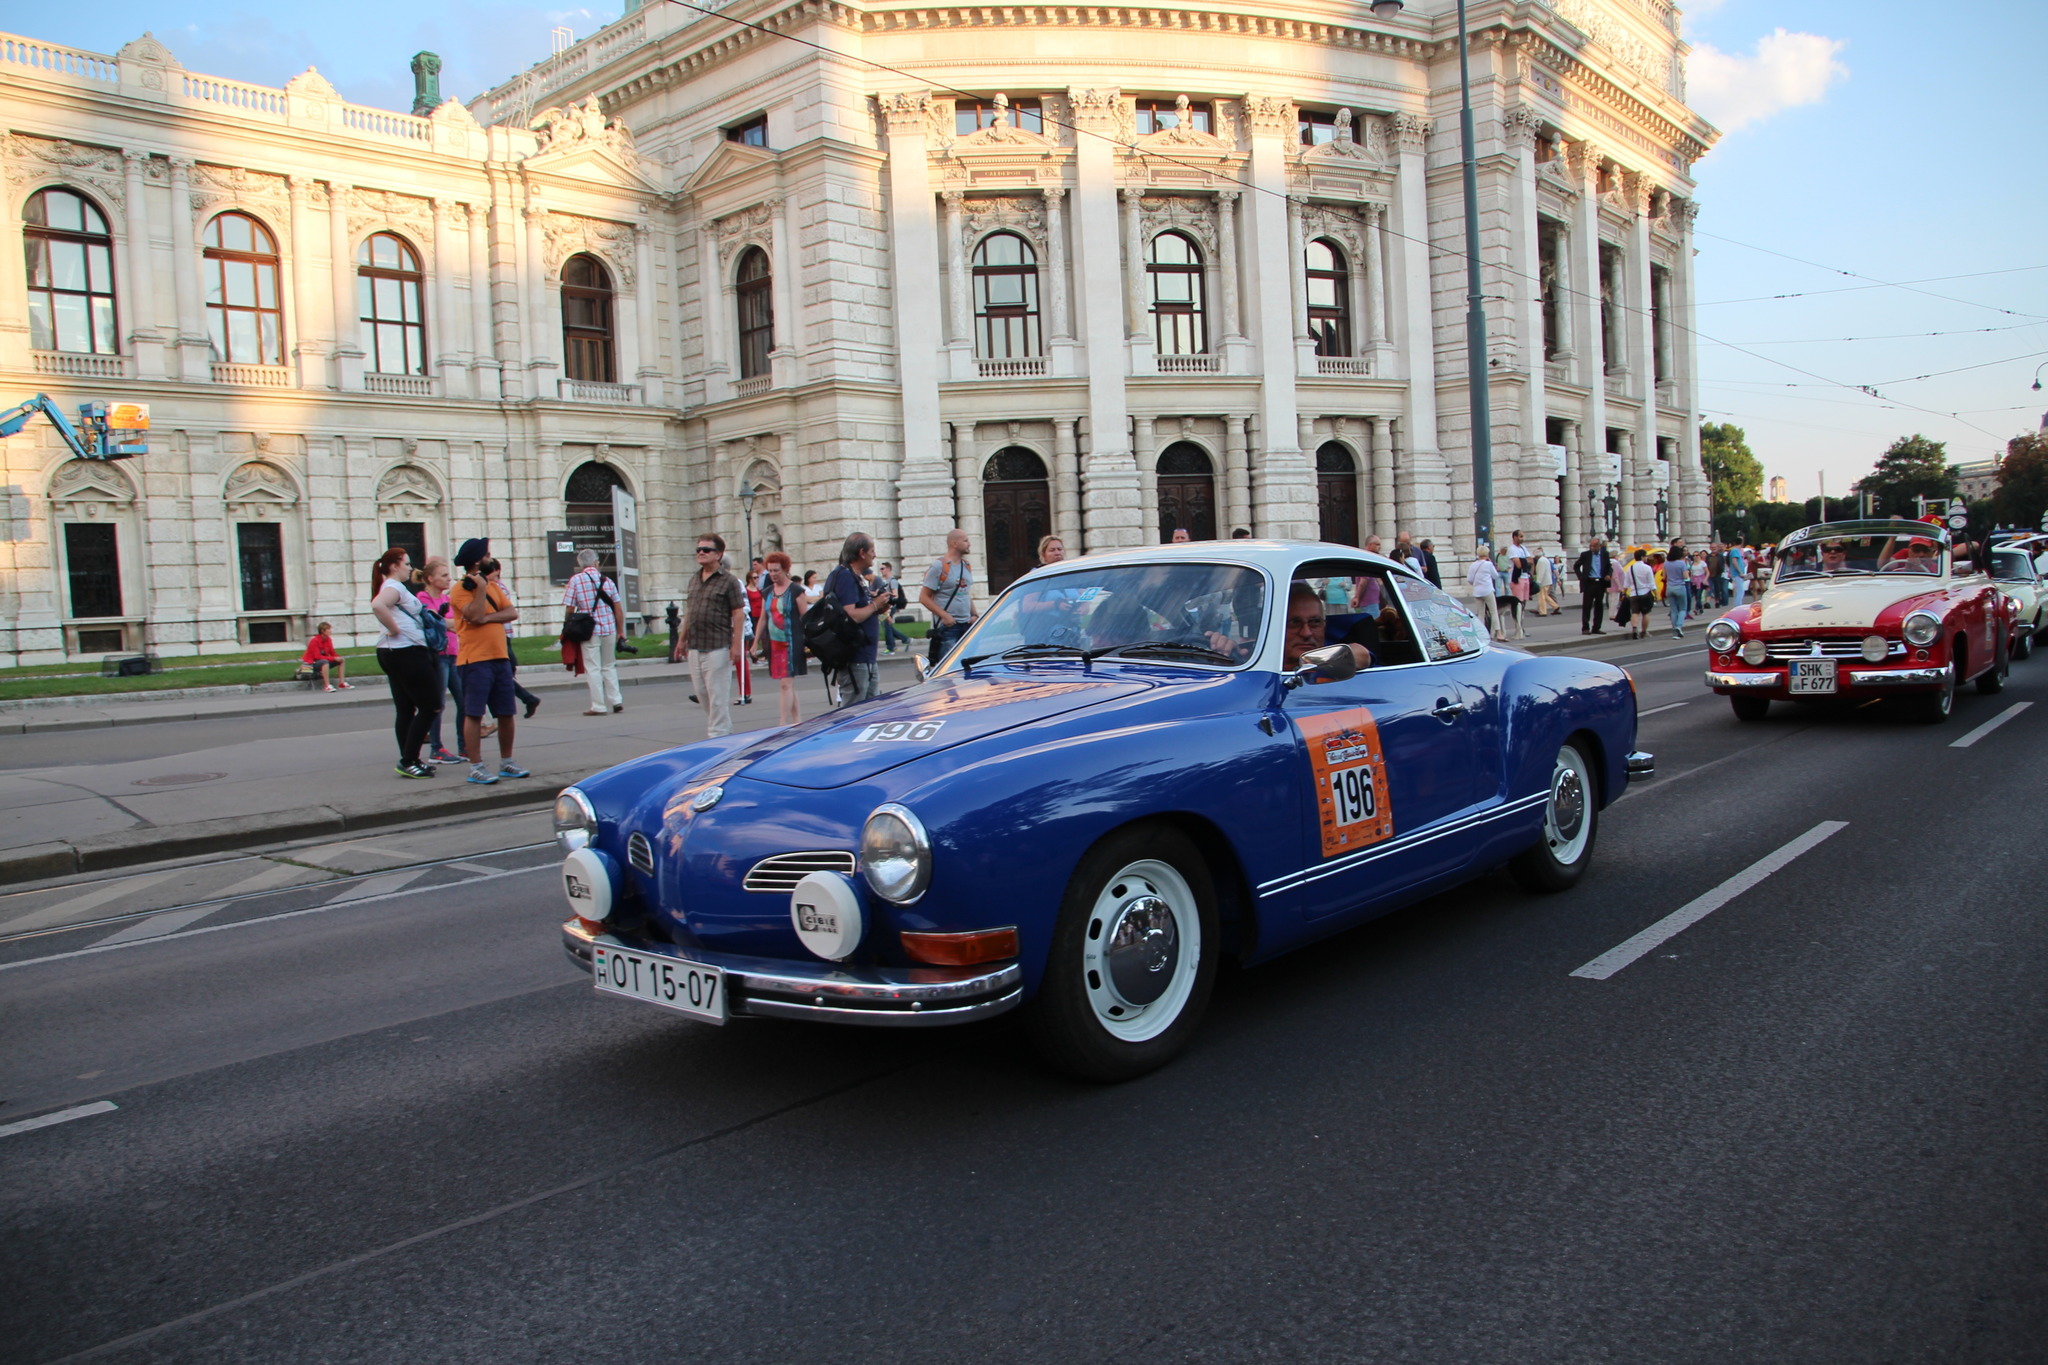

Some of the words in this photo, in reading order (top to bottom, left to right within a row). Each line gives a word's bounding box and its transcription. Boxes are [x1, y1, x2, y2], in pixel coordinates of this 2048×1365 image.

[558, 542, 573, 551] Burg
[1800, 663, 1823, 677] SHK
[1801, 677, 1809, 690] F
[1811, 677, 1833, 690] 677
[866, 721, 942, 742] 196
[1333, 768, 1375, 823] 196
[597, 967, 608, 984] H
[612, 953, 643, 992] OT
[650, 961, 718, 1010] 15-07
